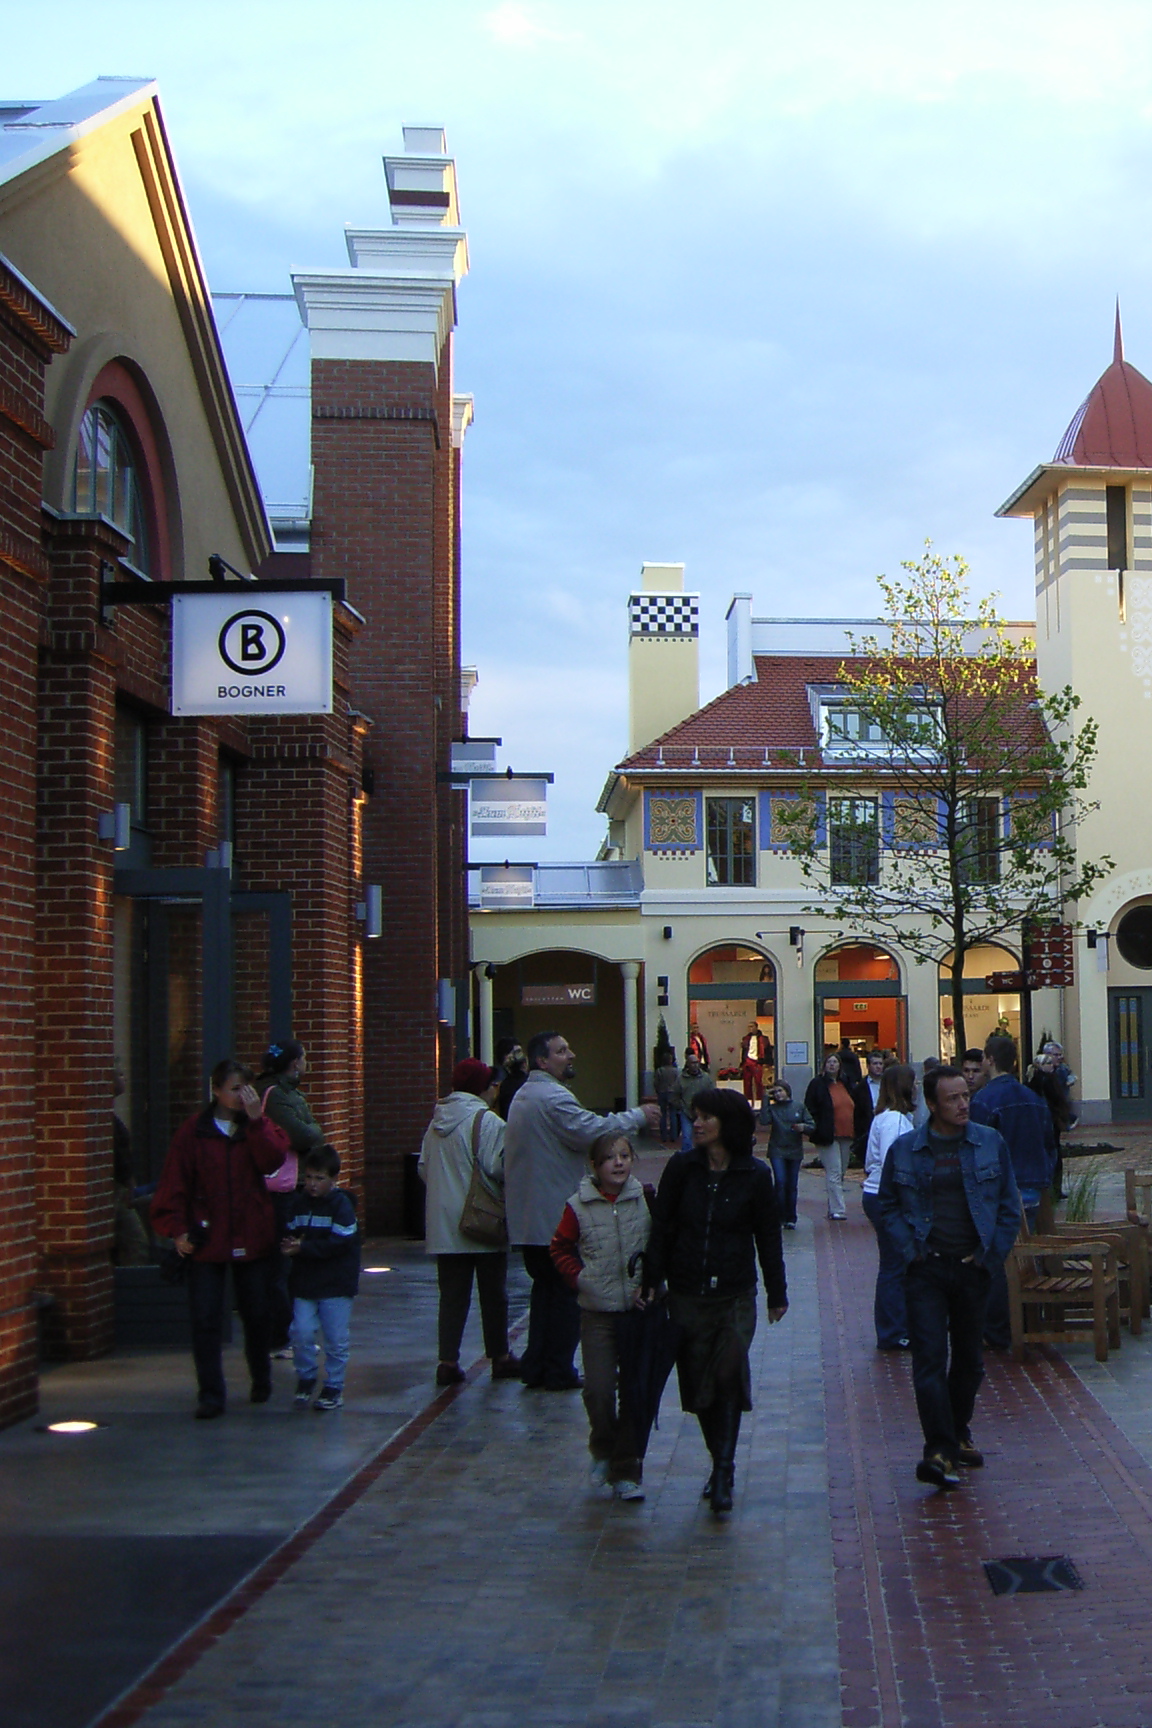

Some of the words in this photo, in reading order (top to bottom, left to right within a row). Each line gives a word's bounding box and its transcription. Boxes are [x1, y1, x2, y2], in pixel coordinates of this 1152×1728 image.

[241, 624, 267, 661] B
[217, 685, 286, 698] BOGNER
[567, 988, 591, 999] WC
